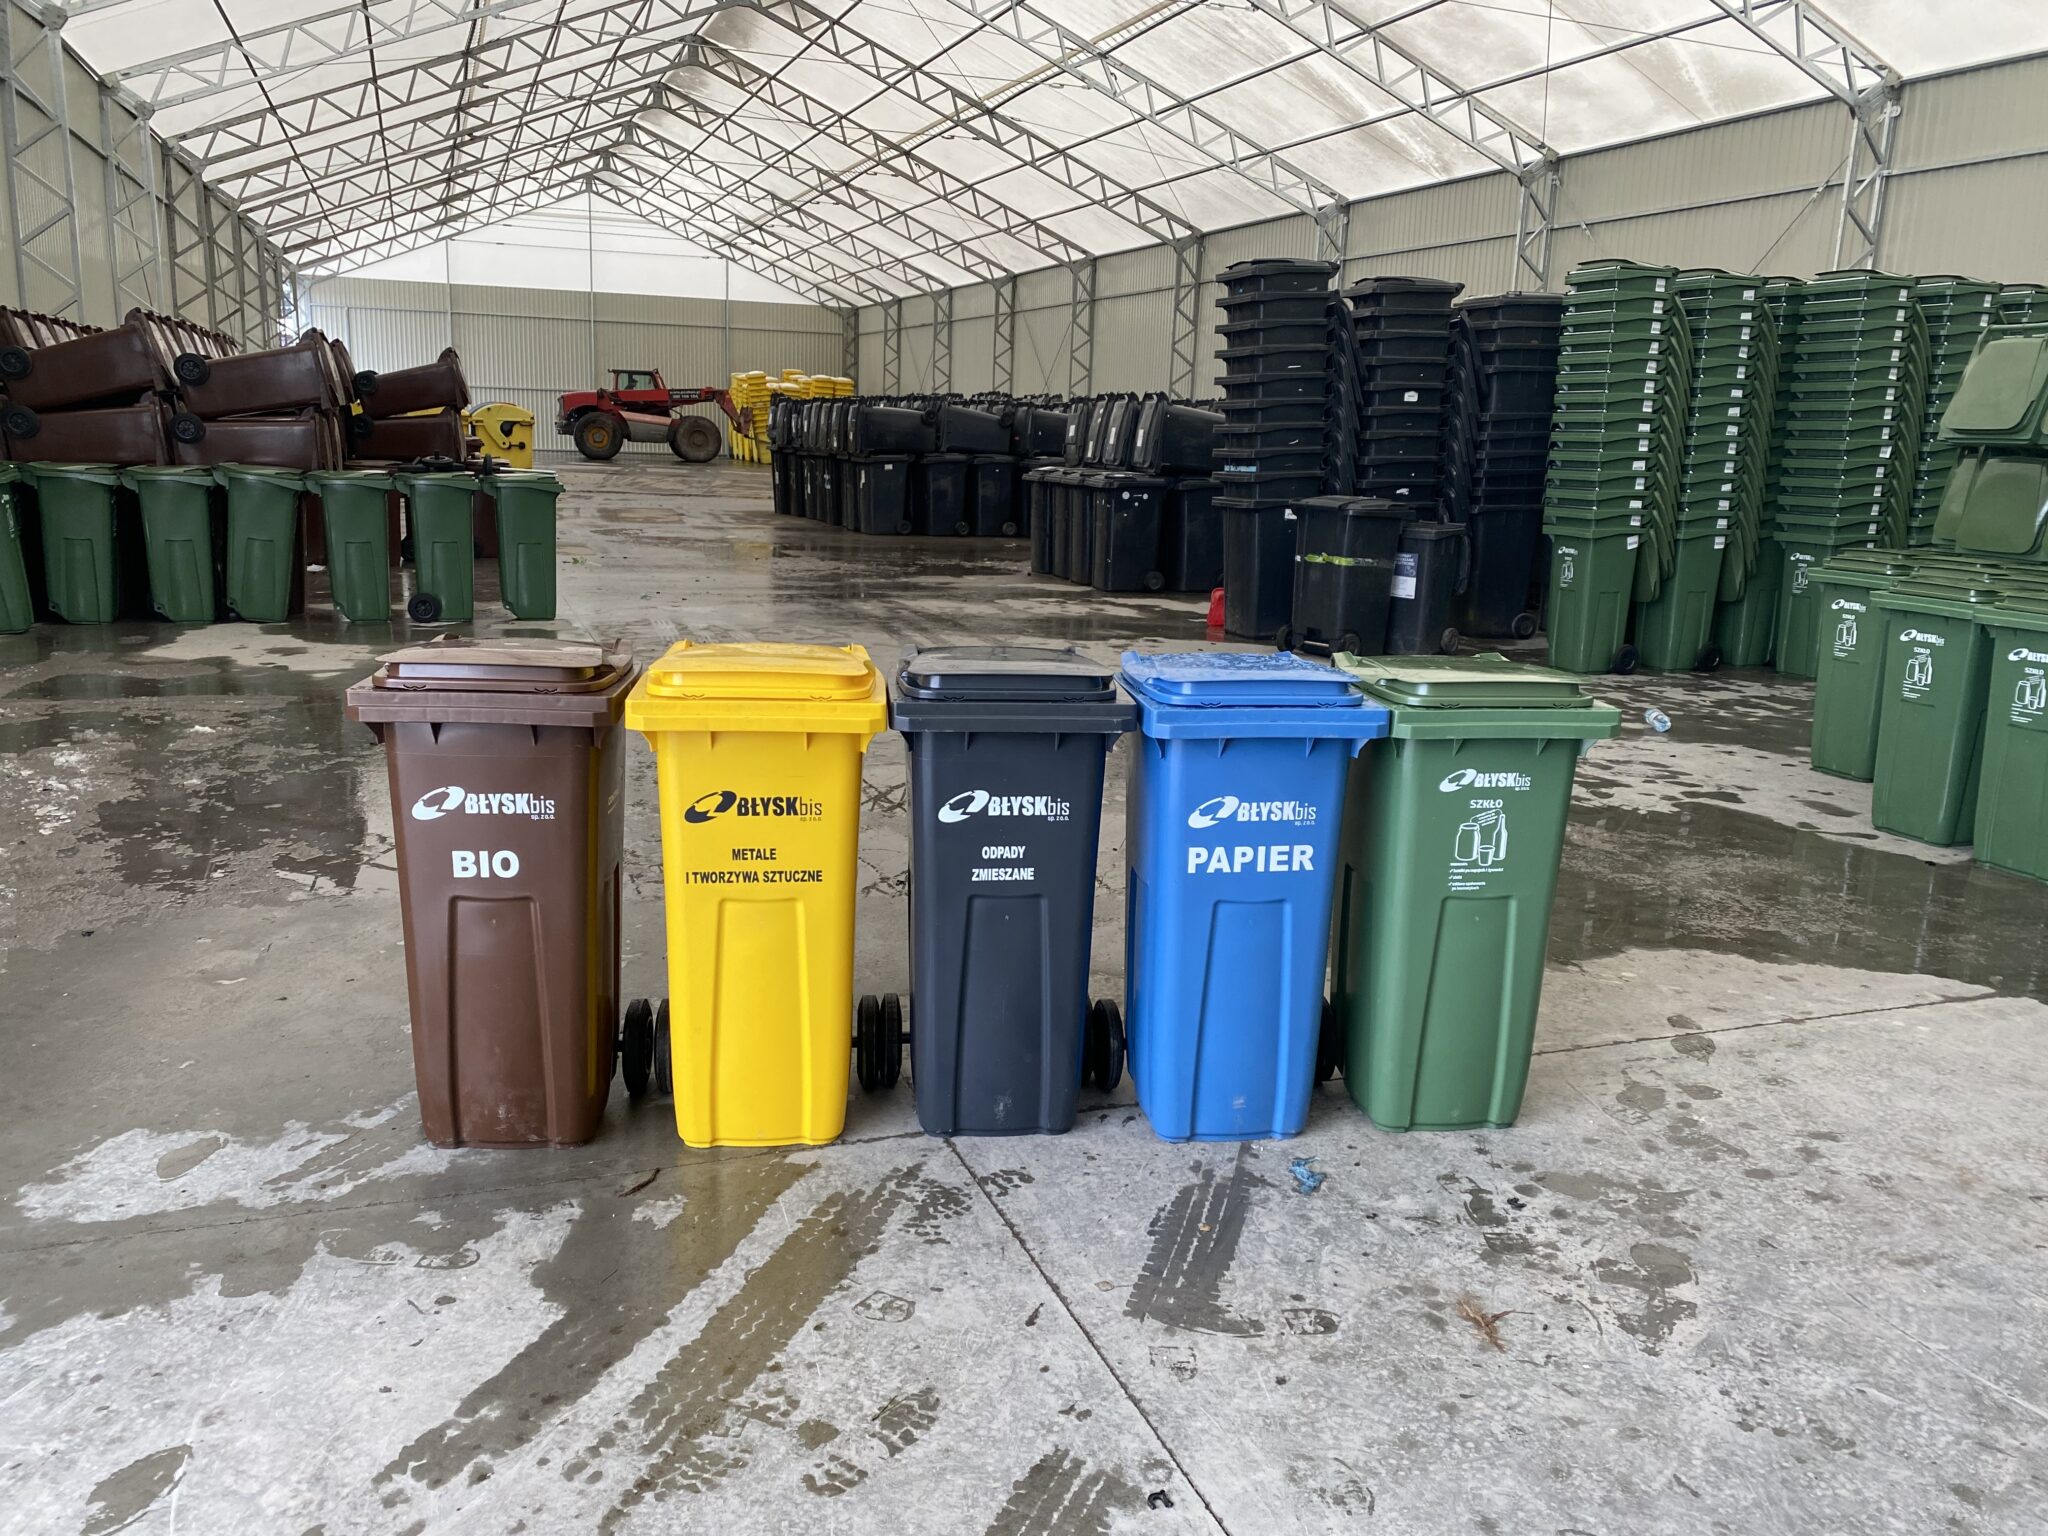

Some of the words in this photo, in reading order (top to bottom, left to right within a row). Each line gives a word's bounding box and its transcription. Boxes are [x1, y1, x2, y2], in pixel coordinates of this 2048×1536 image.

[1474, 772, 1531, 787] BŁYSKbis
[465, 793, 555, 814] BŁYSKbis
[737, 796, 822, 817] BŁYSKbis
[988, 795, 1070, 816] BŁYSKbis
[1237, 801, 1317, 821] BŁYSKbis
[1470, 799, 1503, 809] SZKŁO
[732, 848, 777, 860] METALE
[981, 845, 1026, 859] ODPADY
[1187, 844, 1315, 873] PAPIER
[451, 850, 520, 878] BIO
[685, 872, 689, 884] I
[692, 871, 759, 884] TWORZYWA
[763, 870, 823, 883] SZTUCZNE
[971, 867, 1035, 881] ZMIESZANE
